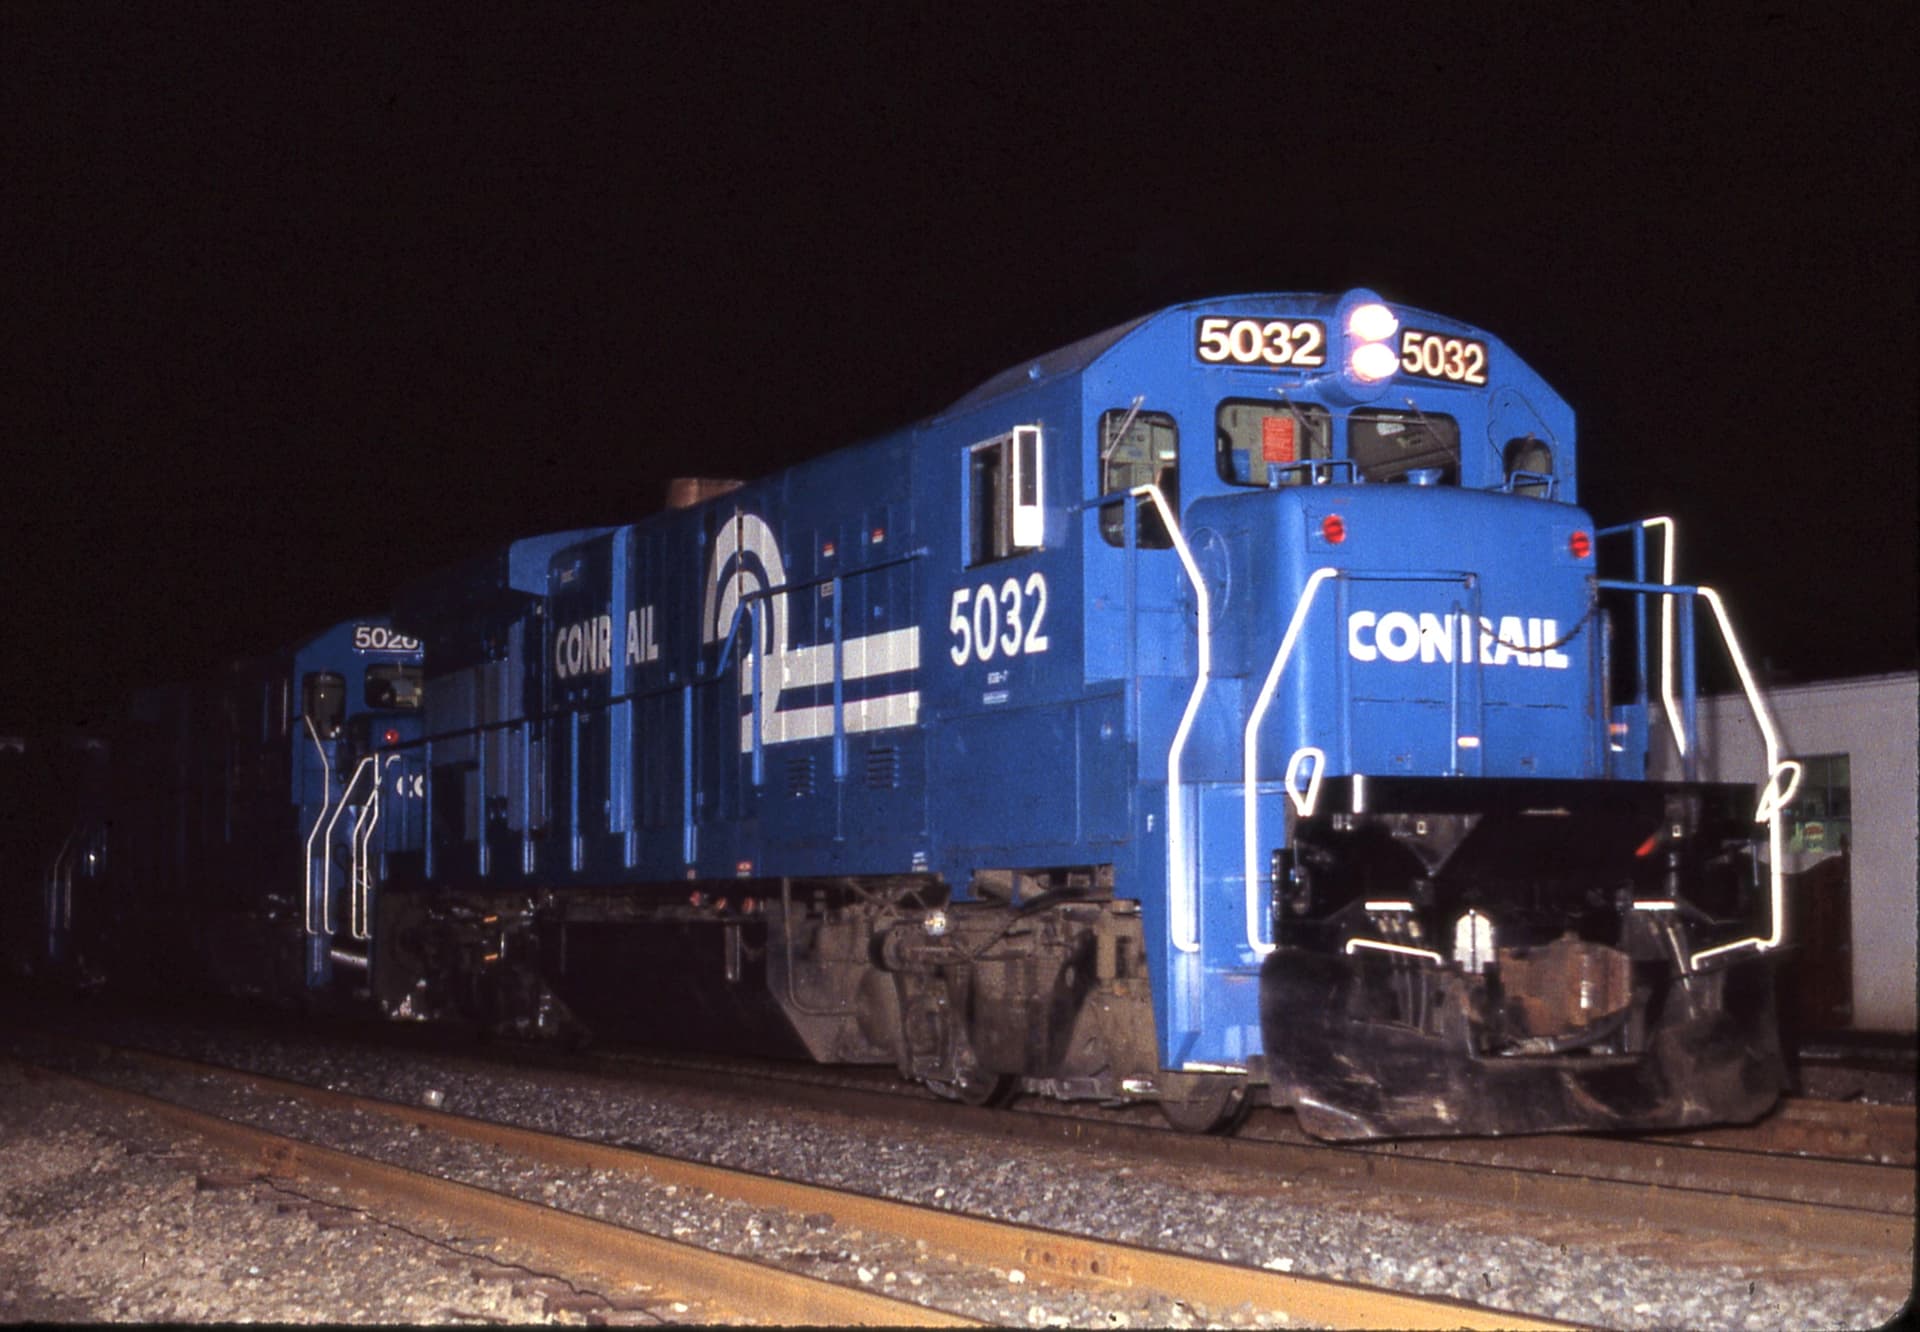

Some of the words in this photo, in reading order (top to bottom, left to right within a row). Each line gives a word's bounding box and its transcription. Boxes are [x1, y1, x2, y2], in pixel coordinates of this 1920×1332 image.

[1199, 318, 1325, 365] 5032
[1401, 331, 1485, 384] 5032
[556, 604, 659, 679] CONRAIL
[950, 572, 1048, 666] 5032
[1348, 611, 1568, 669] CONRAIL
